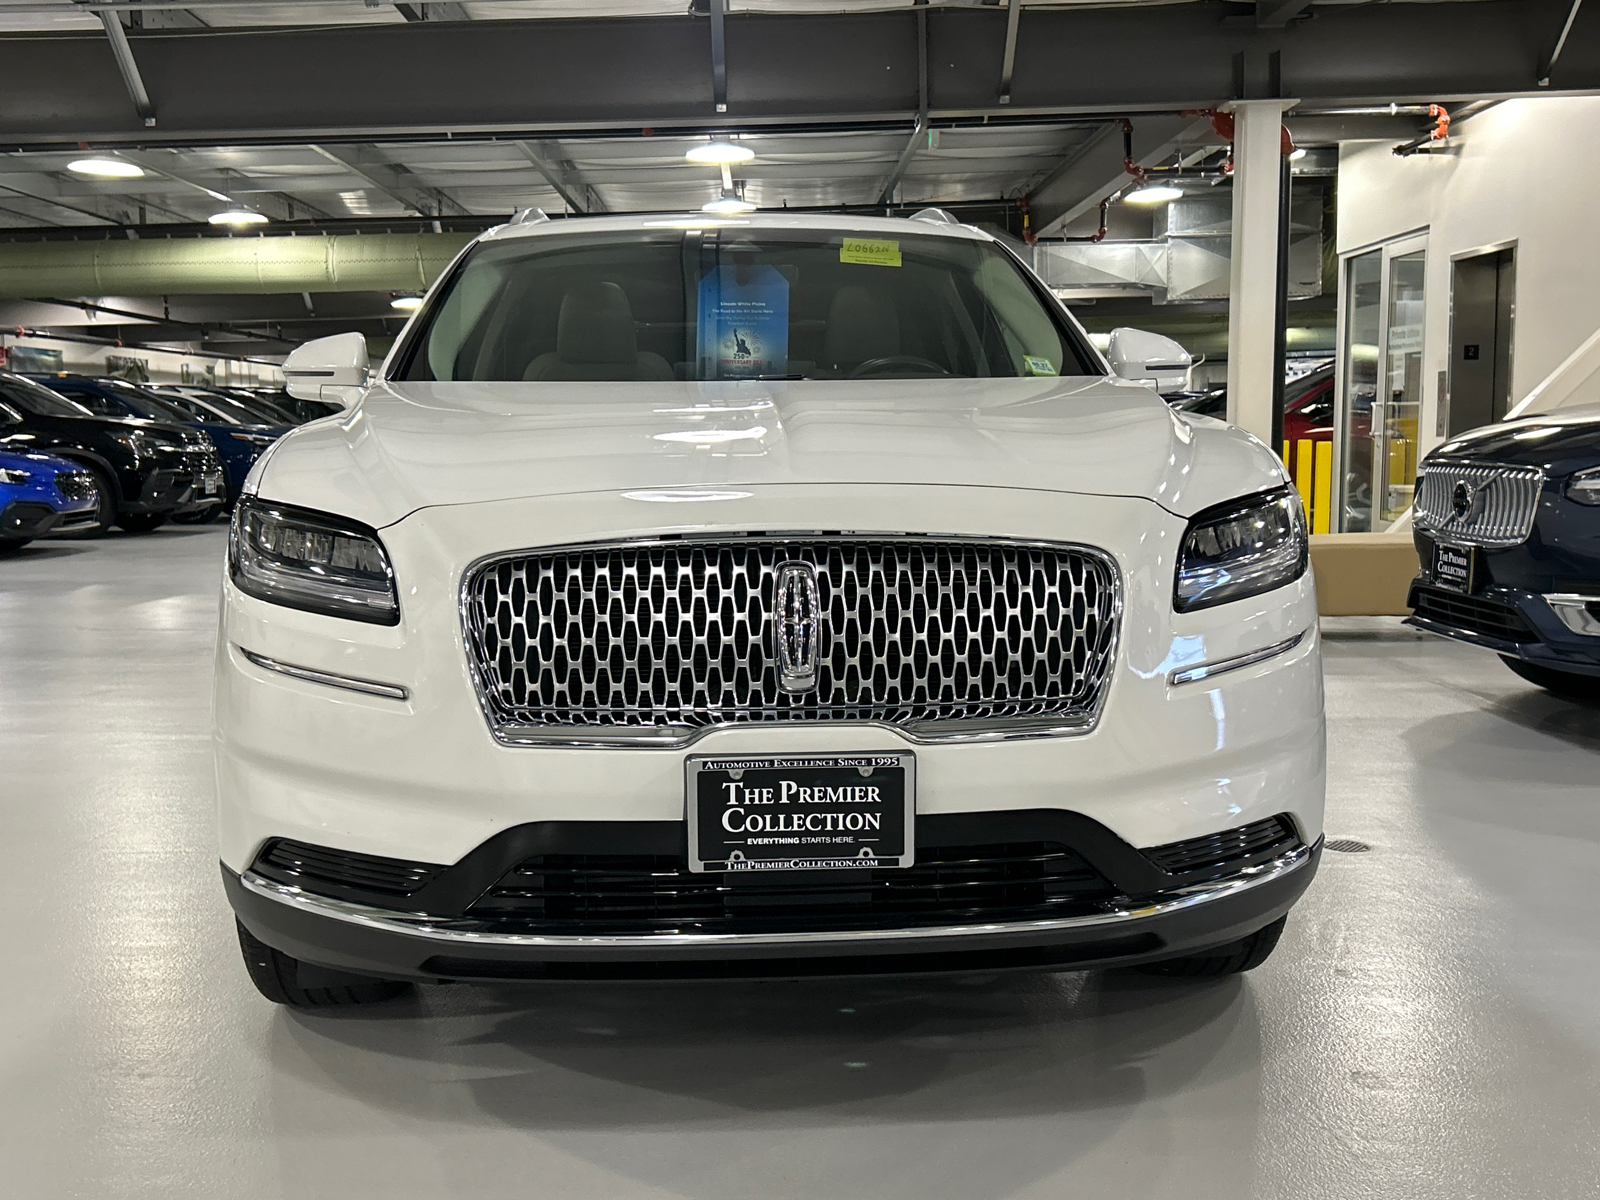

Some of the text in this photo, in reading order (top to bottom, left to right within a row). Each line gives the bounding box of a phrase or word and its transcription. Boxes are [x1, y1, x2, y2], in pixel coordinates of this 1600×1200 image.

[1468, 347, 1475, 356] 2
[870, 757, 898, 766] 1995
[722, 780, 882, 805] THE PREMIER
[721, 807, 882, 833] COLLECTION
[747, 837, 800, 845] EVERYTHING
[801, 836, 831, 844] STARTS
